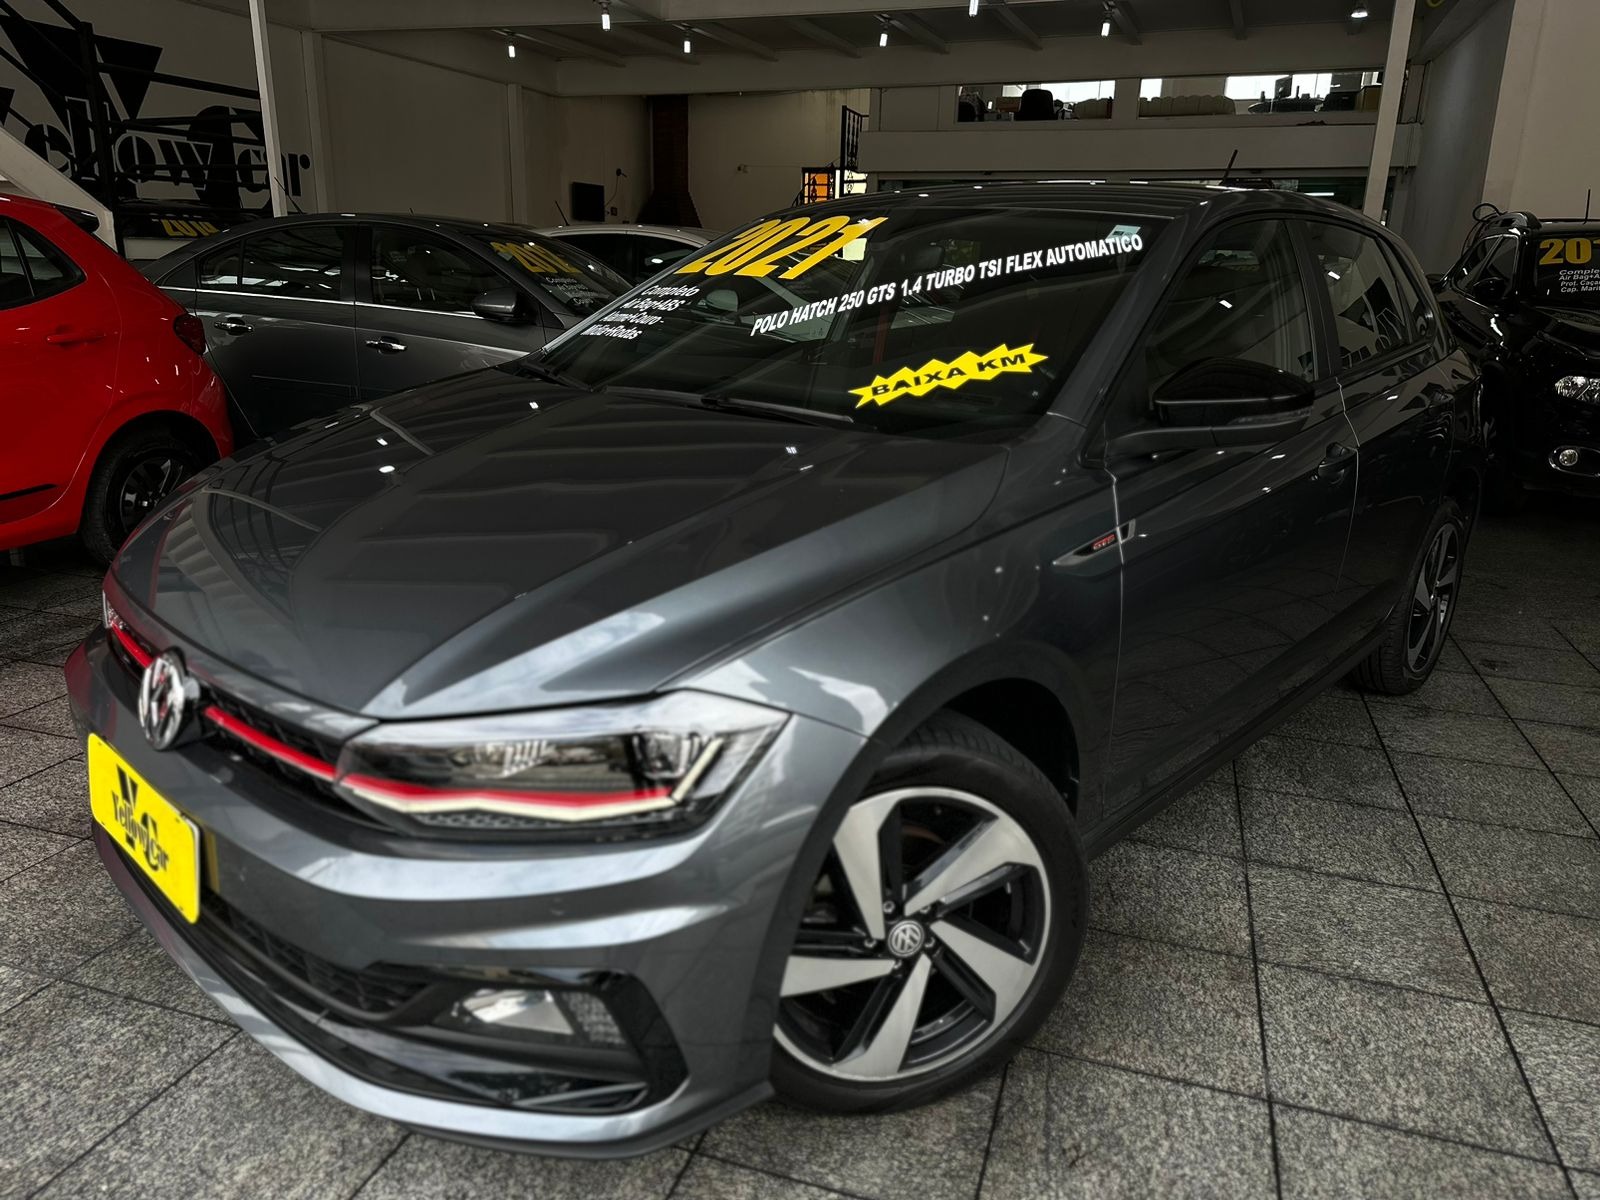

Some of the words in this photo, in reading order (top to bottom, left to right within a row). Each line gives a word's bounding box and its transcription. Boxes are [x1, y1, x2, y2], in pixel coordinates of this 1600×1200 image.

[674, 215, 889, 279] 2021
[641, 284, 700, 297] Completo
[750, 311, 789, 337] POLO
[789, 296, 836, 326] HATCH
[837, 289, 866, 313] 250
[866, 282, 896, 305] GTS
[901, 274, 922, 297] 1.4
[926, 264, 976, 291] TURBO
[978, 258, 1003, 279] TSI
[1005, 250, 1044, 274] FLEX
[1046, 233, 1144, 267] AUTOMATICO
[872, 367, 967, 397] BAIXA
[977, 354, 1026, 373] KM
